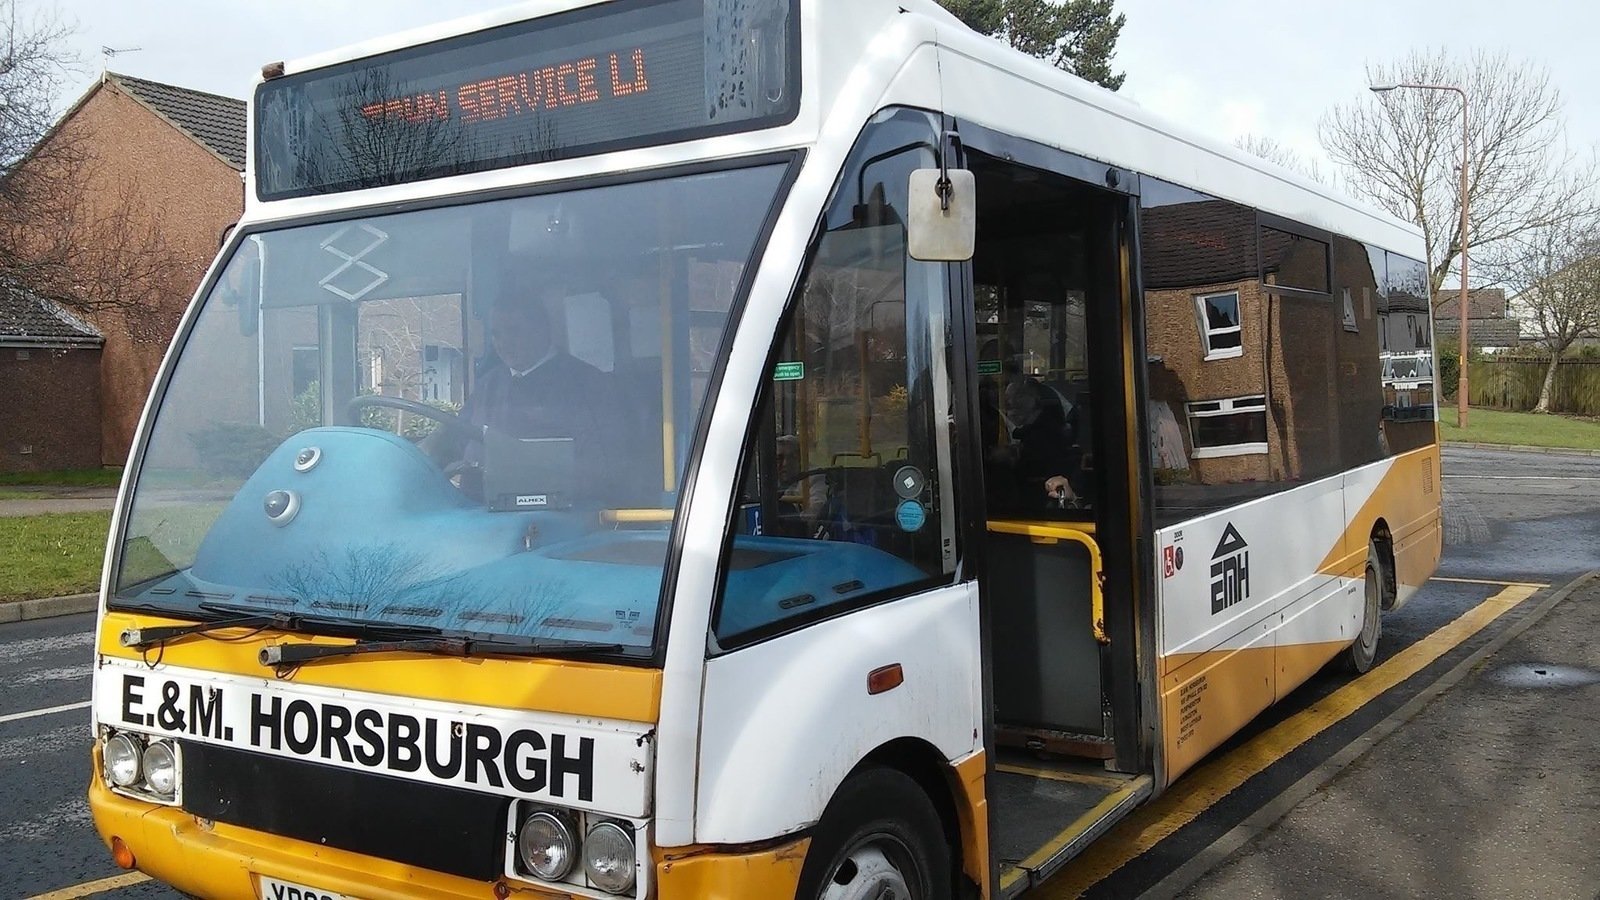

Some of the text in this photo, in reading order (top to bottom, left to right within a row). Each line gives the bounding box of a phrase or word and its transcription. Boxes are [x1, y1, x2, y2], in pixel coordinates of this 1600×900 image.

[457, 58, 599, 124] SERVICE
[122, 674, 594, 802] E.&M. HORSBURGH
